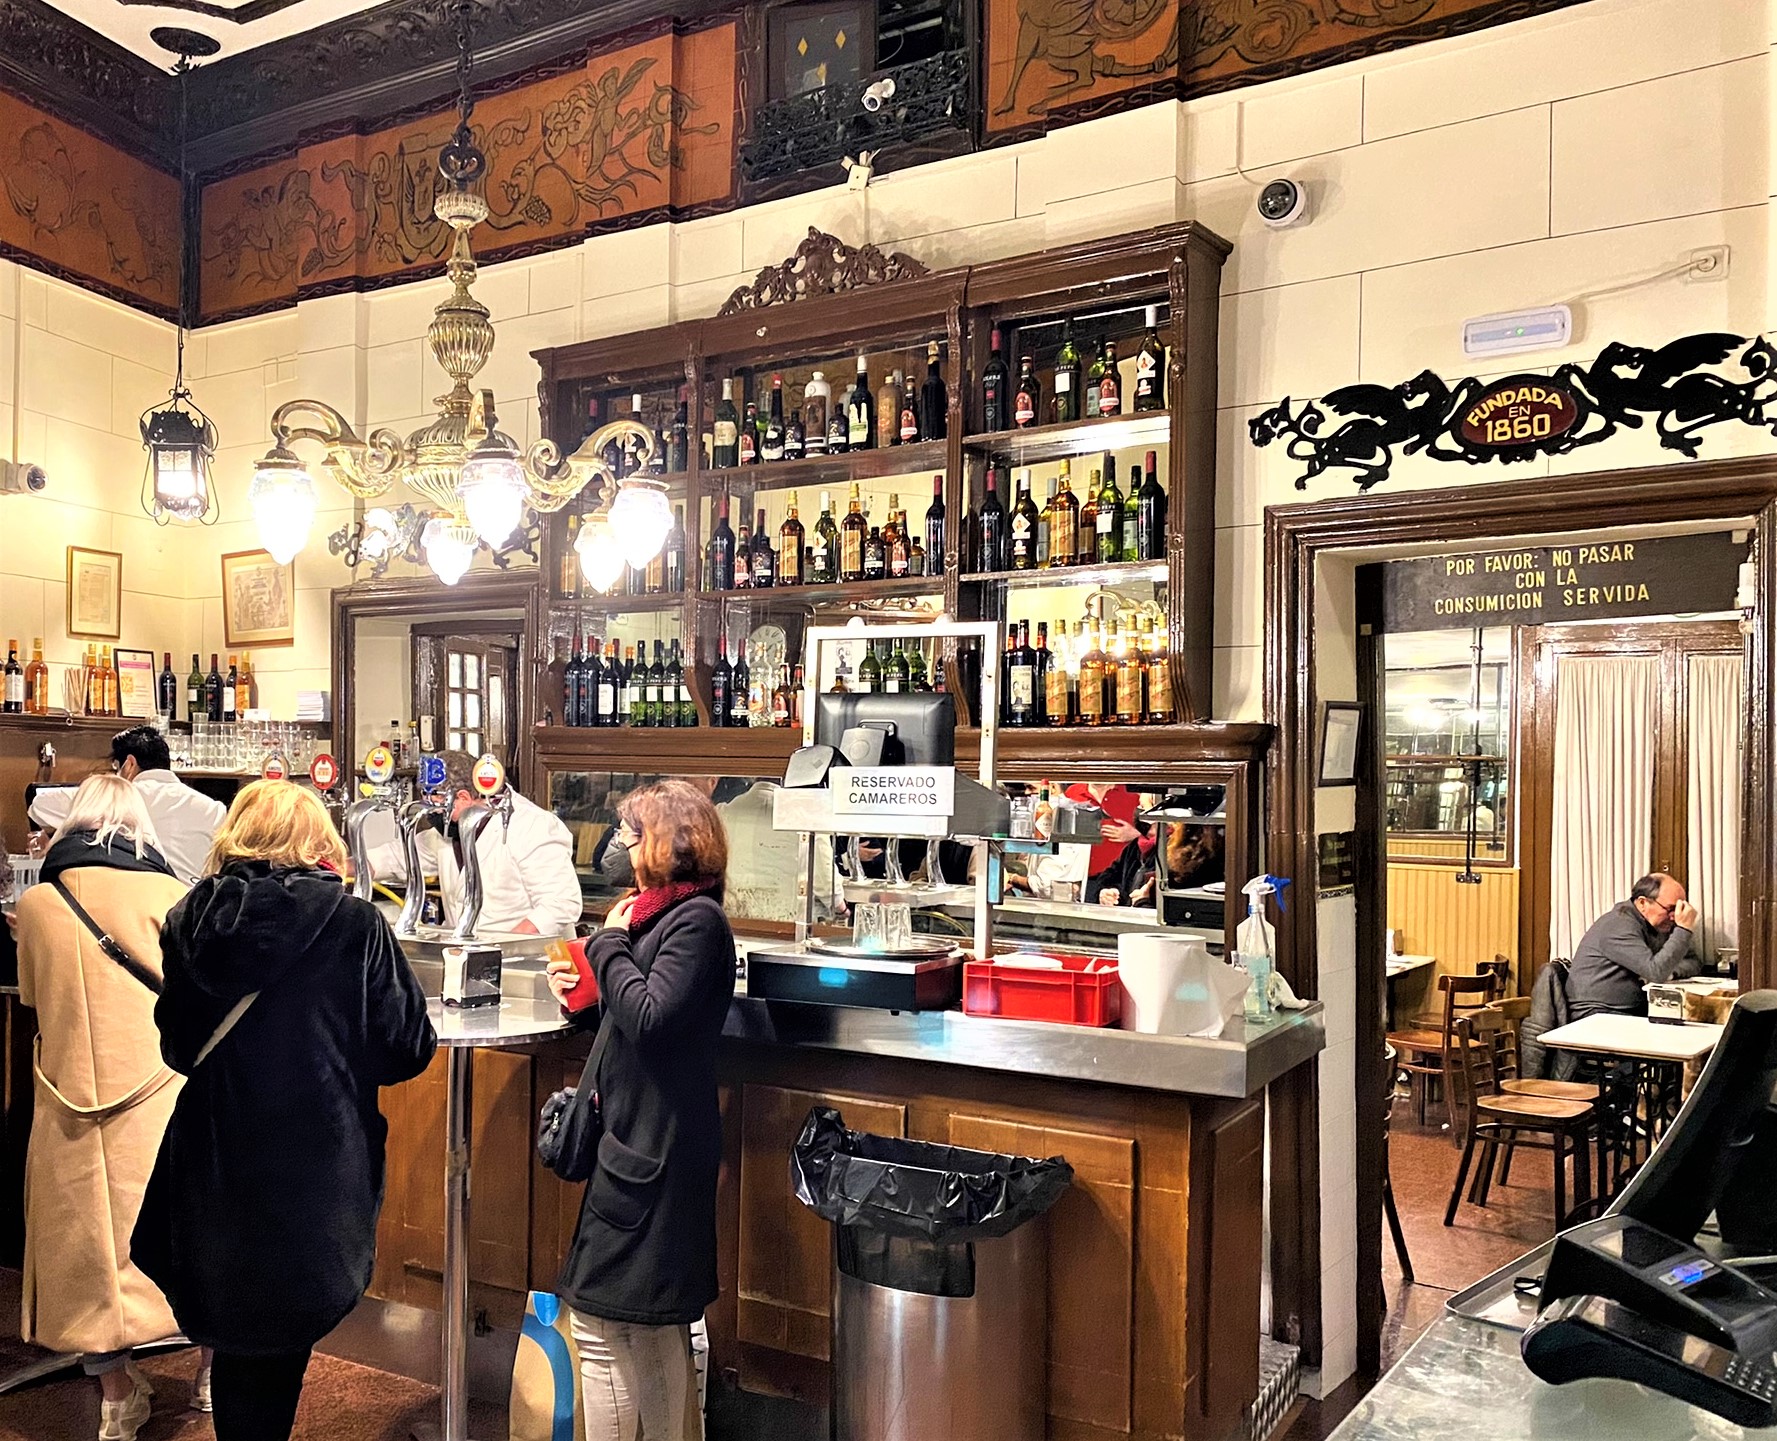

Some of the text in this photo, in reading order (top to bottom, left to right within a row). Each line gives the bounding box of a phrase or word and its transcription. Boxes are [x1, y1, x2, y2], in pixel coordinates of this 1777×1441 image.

[1466, 387, 1563, 427] FUNDADA
[1508, 405, 1531, 418] EN
[1484, 413, 1551, 443] 1860
[1446, 543, 1635, 577] POR FAVOR: NO PASAR
[1515, 568, 1579, 589] CON LA
[1434, 584, 1650, 616] CONSUMICION SERVIDA
[851, 776, 937, 789] RESERVADO
[848, 792, 938, 805] CAMAREROS
